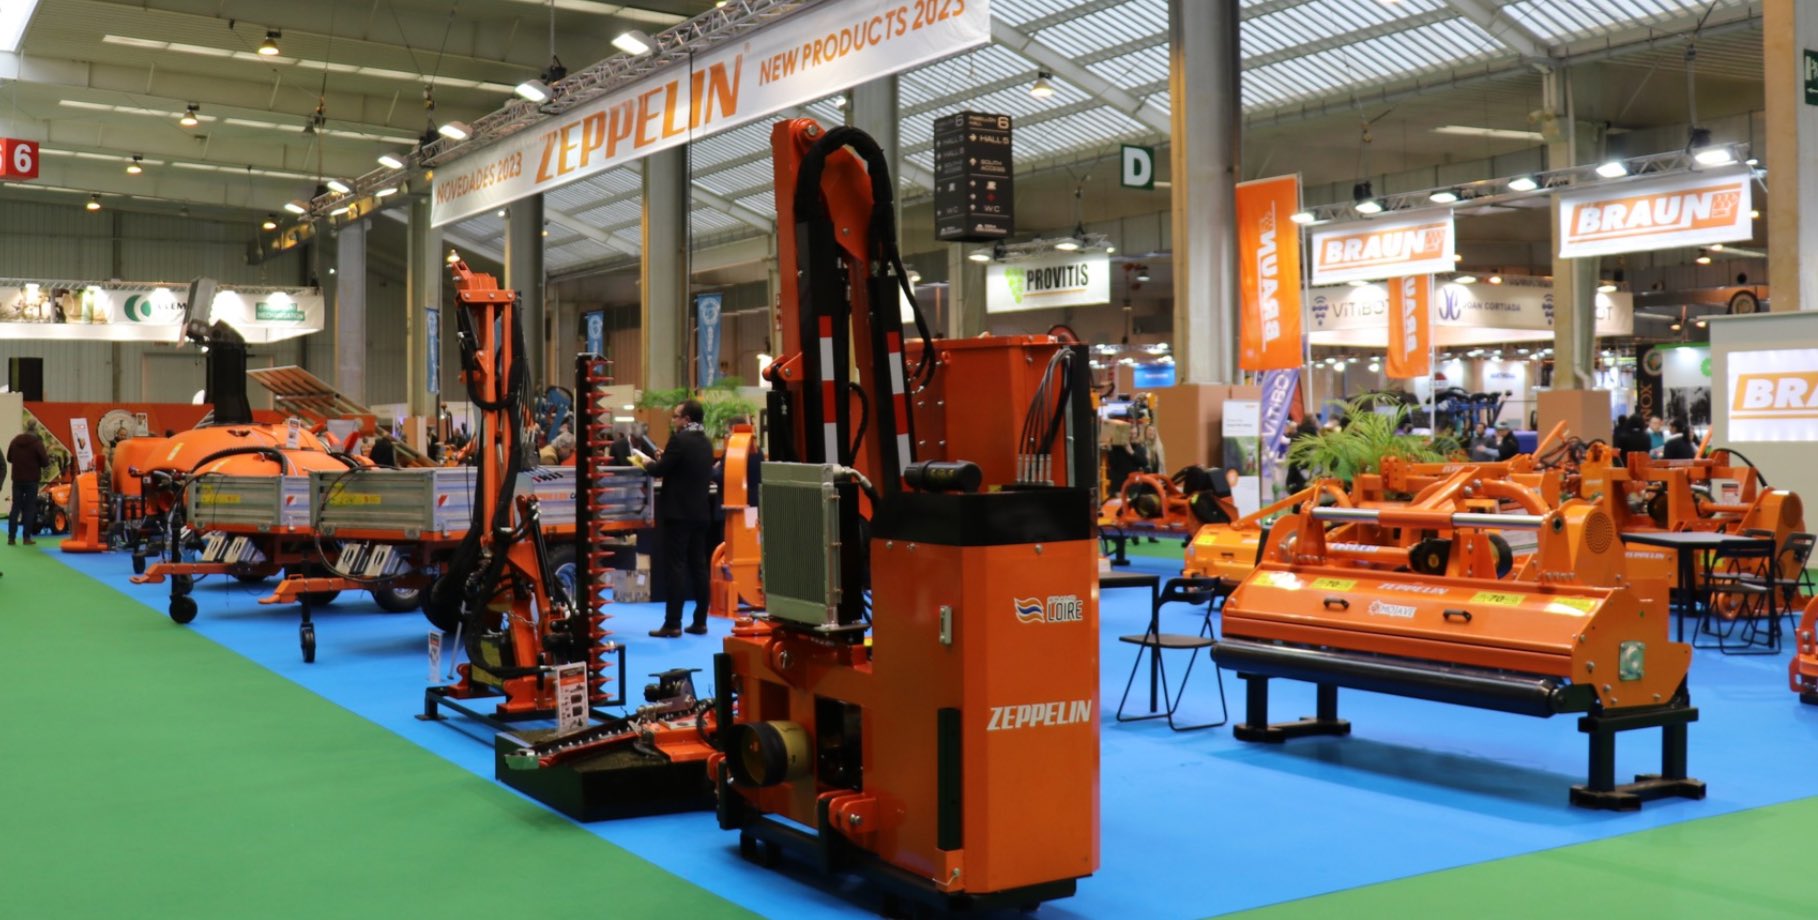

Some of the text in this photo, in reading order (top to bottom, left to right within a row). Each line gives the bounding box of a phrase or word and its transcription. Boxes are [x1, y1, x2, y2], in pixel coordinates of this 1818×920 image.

[758, 0, 965, 87] NEW PRODUCTS 2023
[535, 53, 743, 184] ZEPPELIN
[997, 116, 1009, 129] 6
[13, 143, 32, 173] 6
[1123, 146, 1152, 187] D
[437, 151, 523, 204] NOVEDADES 2023
[984, 204, 1000, 213] WC
[1578, 191, 1711, 234] BRAUN
[1326, 229, 1426, 263] BRAUN
[1026, 263, 1089, 291] PROVITIS
[1257, 229, 1281, 342] BRAUN
[1331, 299, 1390, 318] ViTiBO
[1403, 276, 1418, 353] BRAU
[1048, 601, 1082, 621] LOIRE
[1489, 594, 1504, 603] 70
[986, 699, 1092, 731] ZEPPELIN
